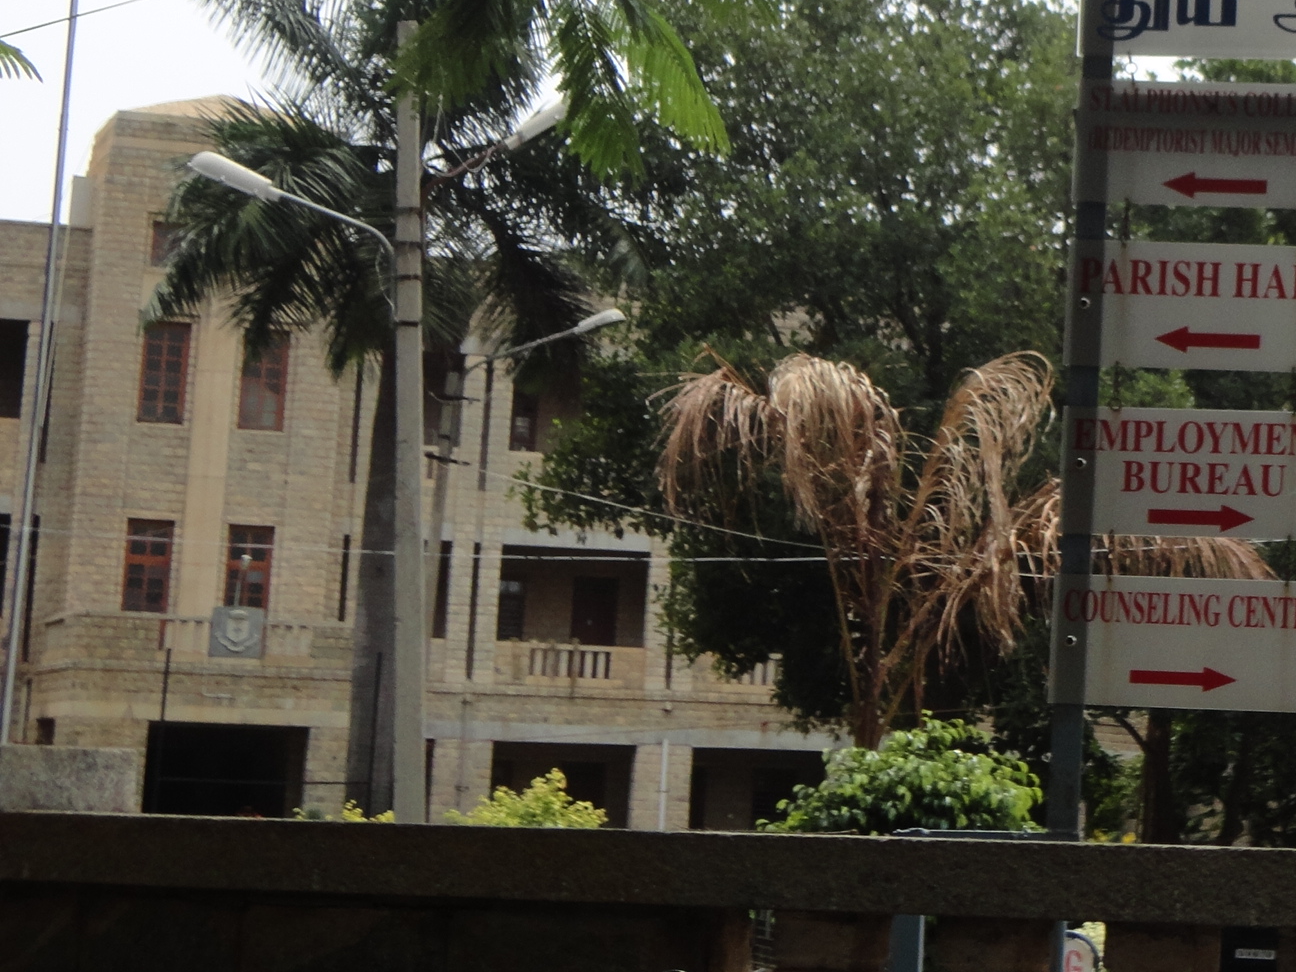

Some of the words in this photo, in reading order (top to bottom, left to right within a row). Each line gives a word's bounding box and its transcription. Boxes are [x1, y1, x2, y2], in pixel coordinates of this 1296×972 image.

[1210, 129, 1262, 157] MAJOR
[1079, 257, 1223, 299] PARISH
[1120, 460, 1287, 497] BUREAU
[1063, 588, 1221, 628] COUNSELING
